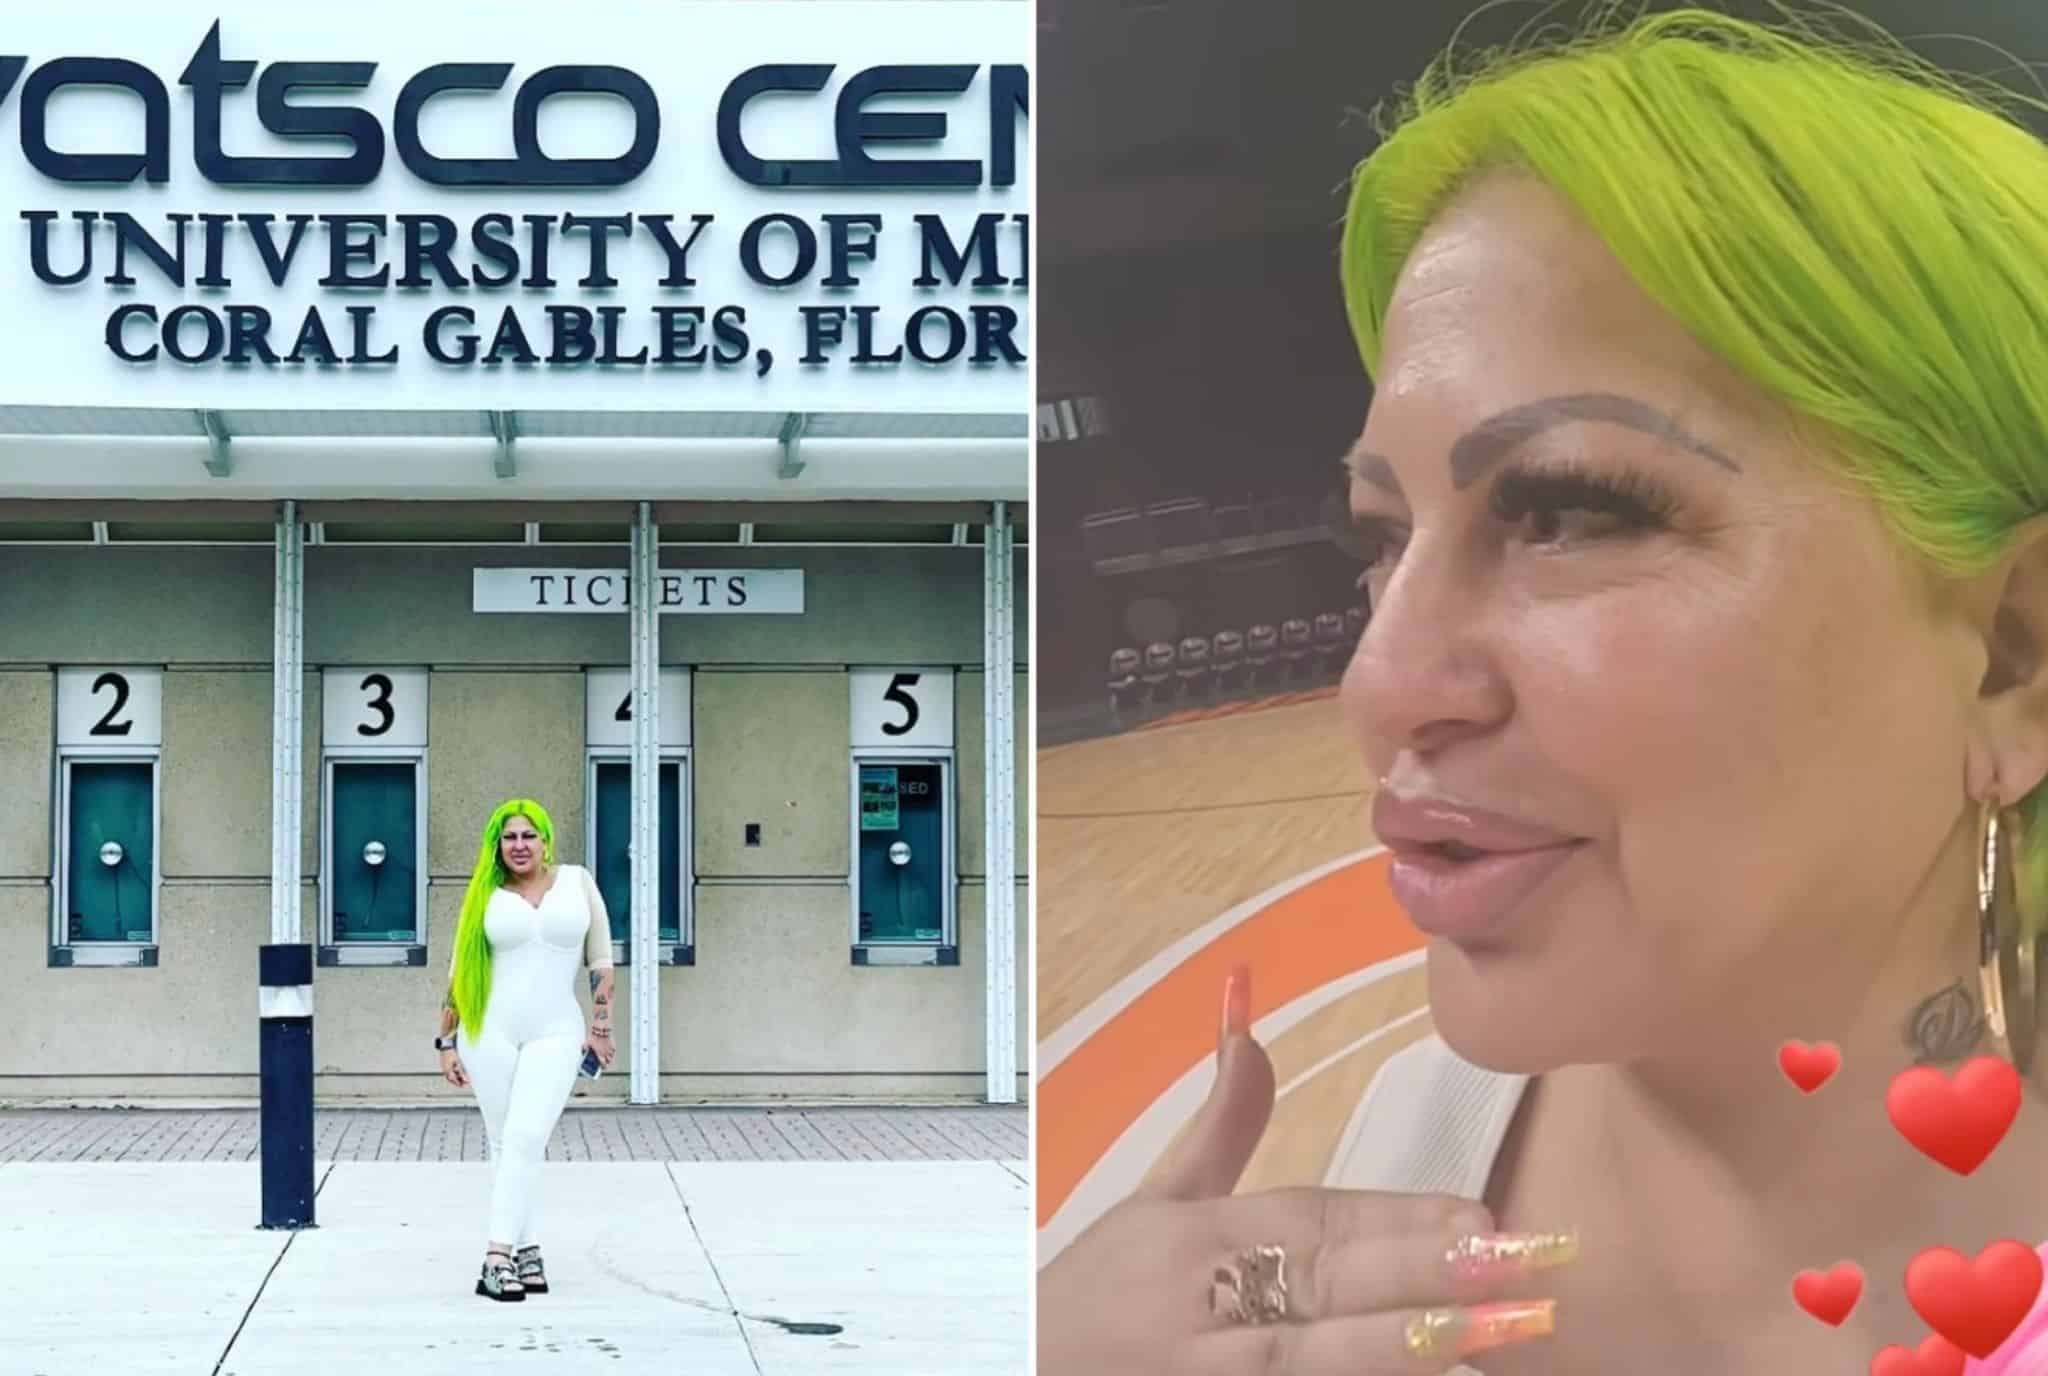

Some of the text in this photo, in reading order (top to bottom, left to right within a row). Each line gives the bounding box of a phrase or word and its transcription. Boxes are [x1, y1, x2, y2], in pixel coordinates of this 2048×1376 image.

[21, 212, 713, 288] UNIVERSITY
[740, 214, 882, 287] OF
[105, 304, 1027, 377] CORAL GABLES, FLOR
[90, 673, 133, 736] 2
[357, 674, 395, 736] 3
[881, 673, 921, 736] 5
